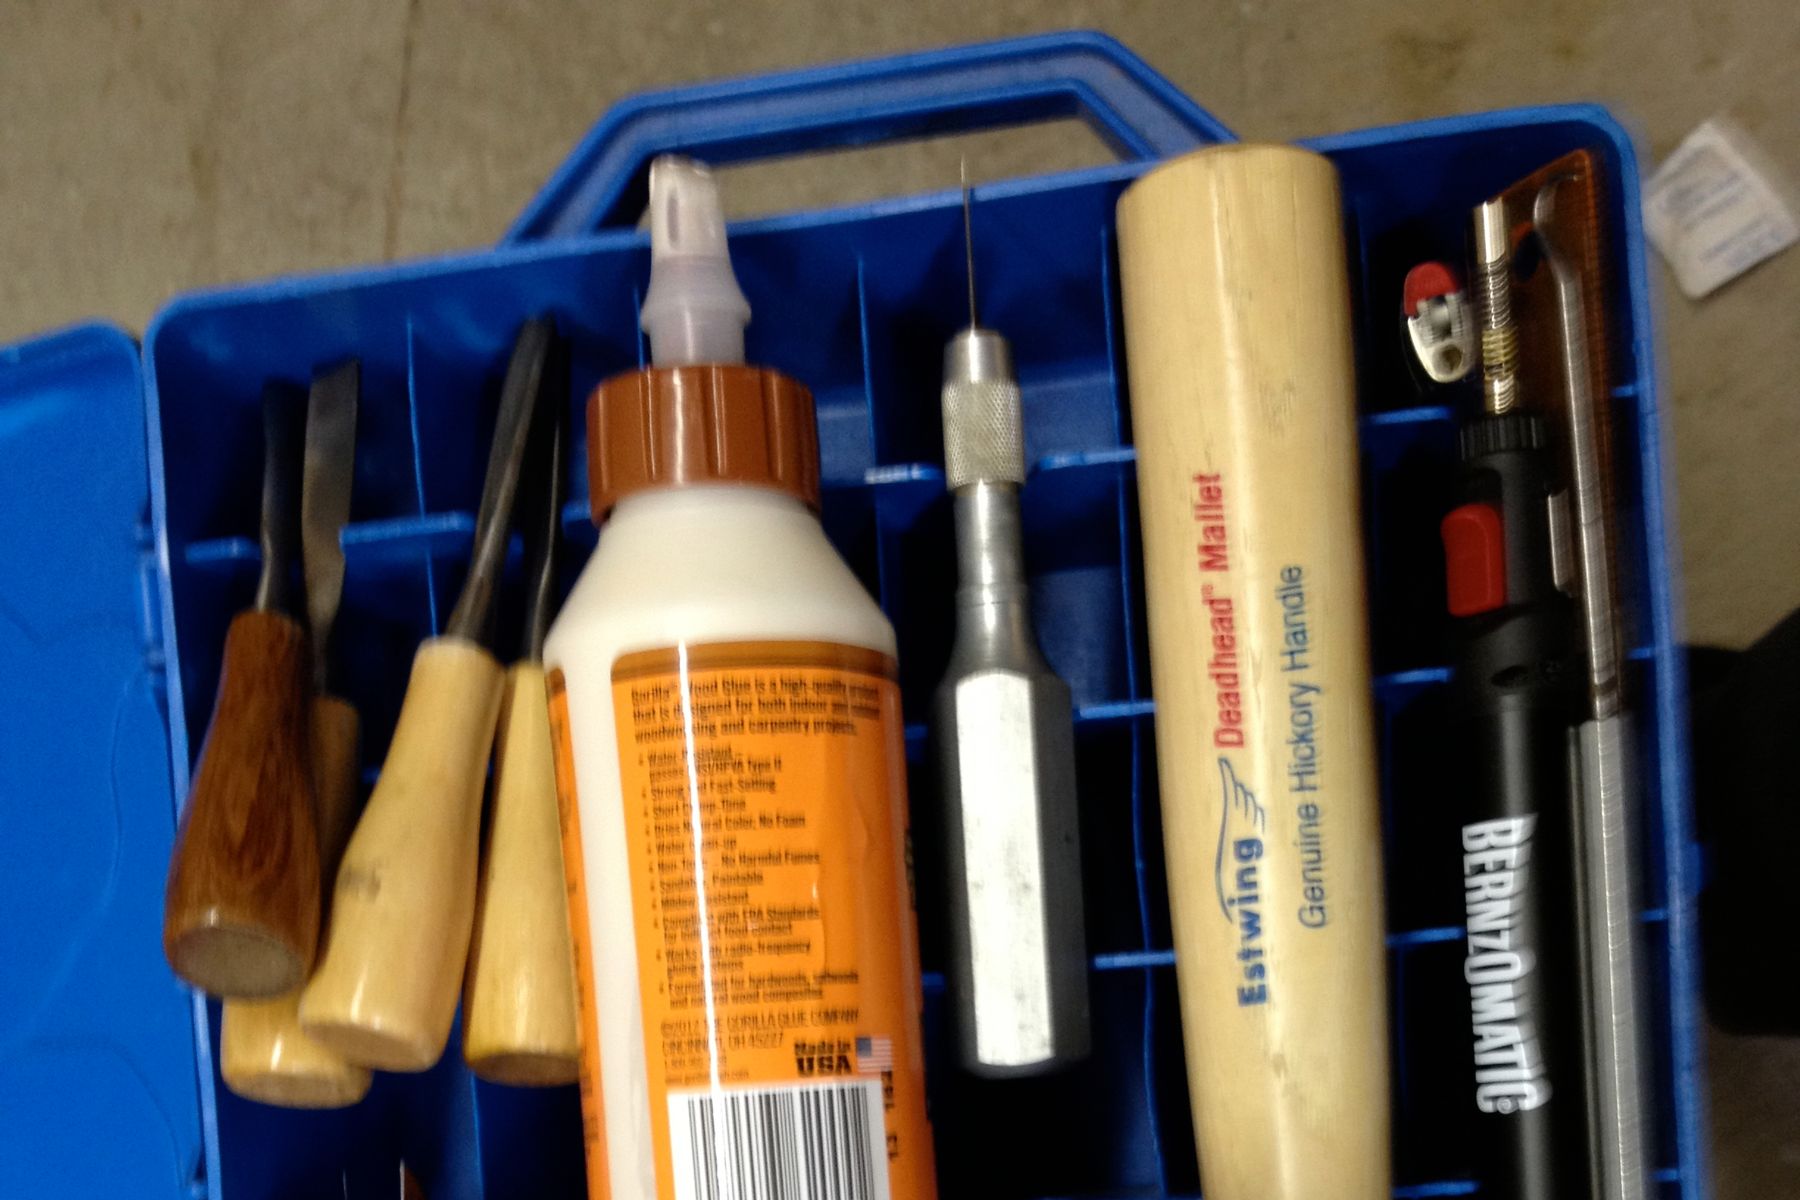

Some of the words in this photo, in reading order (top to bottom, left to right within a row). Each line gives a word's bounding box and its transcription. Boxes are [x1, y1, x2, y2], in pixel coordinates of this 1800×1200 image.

[1194, 473, 1229, 572] Mallet
[1276, 564, 1309, 672] Handle
[722, 676, 750, 694] Glue
[633, 708, 656, 727] that
[736, 698, 753, 714] for
[758, 697, 786, 713] both
[721, 719, 745, 735] and
[749, 719, 809, 736] carpentry
[1287, 678, 1321, 792] Hickory
[759, 814, 773, 829] No
[1292, 804, 1326, 929] Genuine
[1229, 838, 1266, 1006] Estwing
[794, 1037, 834, 1056] Made
[837, 1035, 851, 1053] in
[796, 1055, 853, 1077] USA
